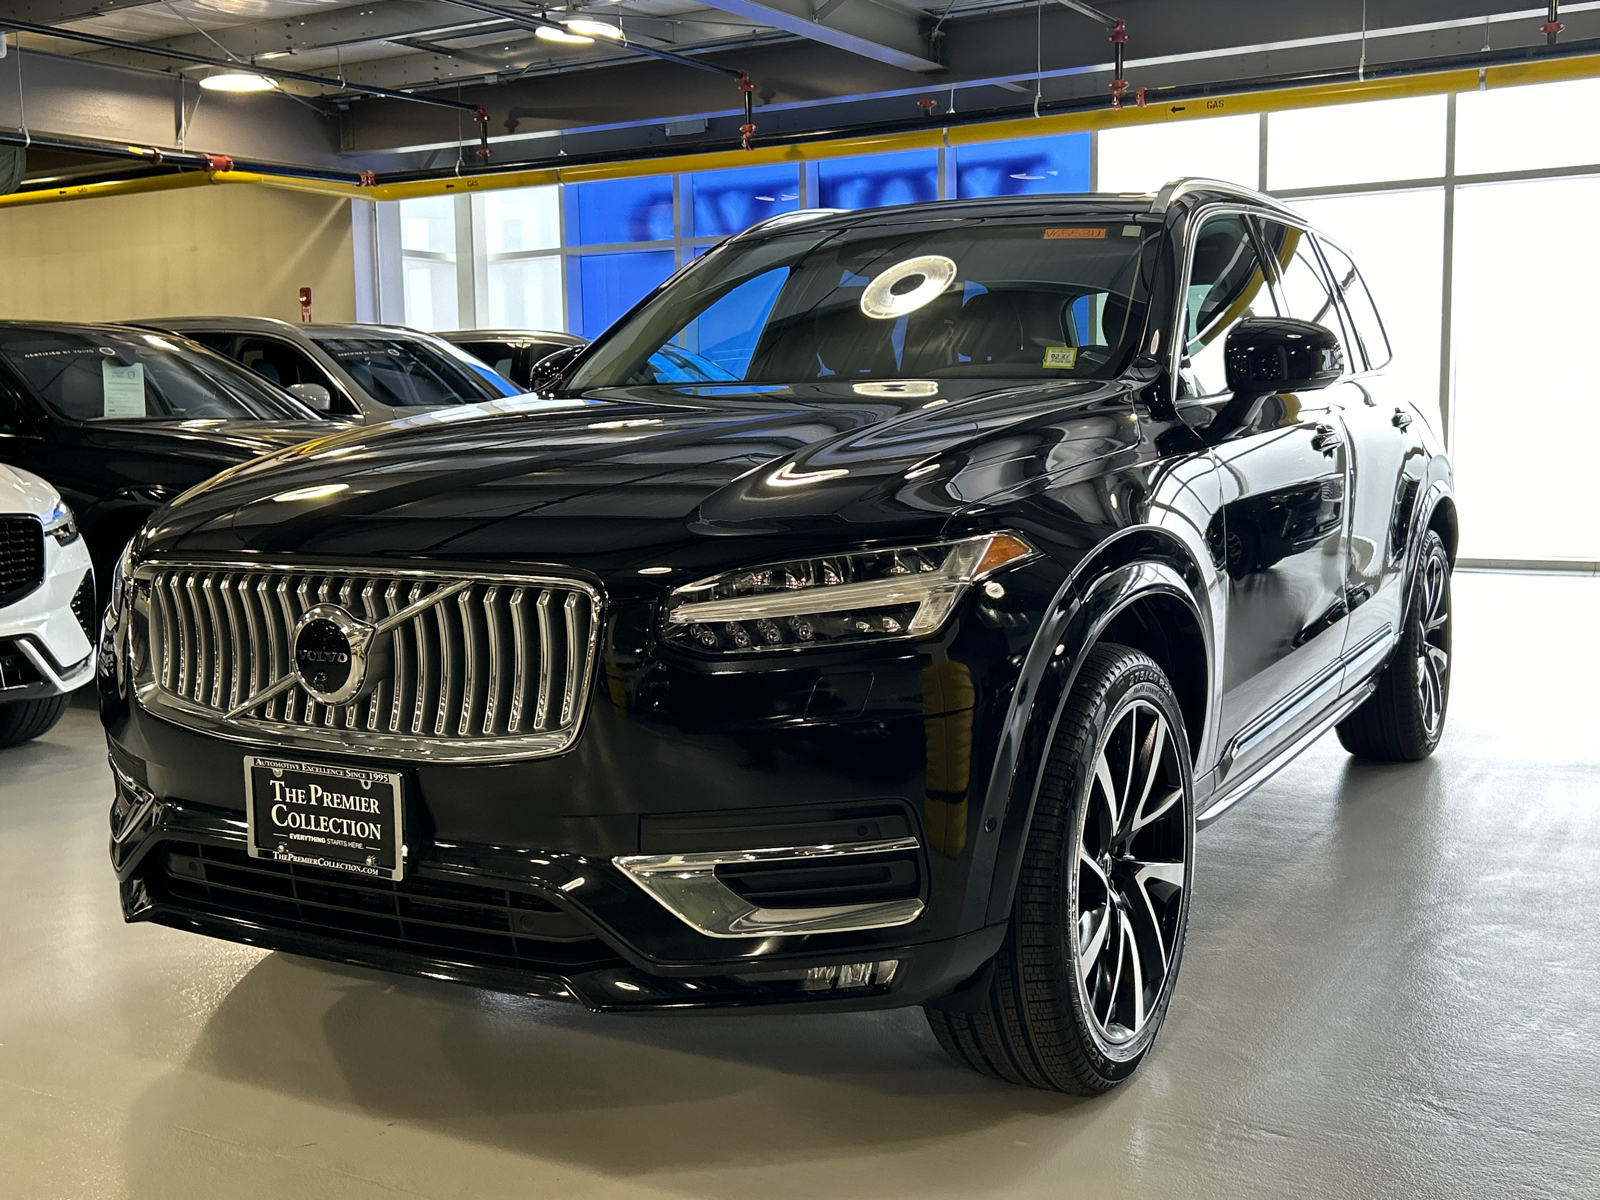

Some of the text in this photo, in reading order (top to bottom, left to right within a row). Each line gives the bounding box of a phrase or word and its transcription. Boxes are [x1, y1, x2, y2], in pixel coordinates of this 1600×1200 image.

[1206, 99, 1225, 110] GAS
[466, 179, 479, 188] GAS
[297, 649, 348, 663] VOLVO
[1128, 670, 1159, 687] 275/40
[255, 758, 389, 782] AUTOMOTIVE EXCELLENCE SINCE 1995
[269, 779, 381, 815] THE PREMIER
[271, 803, 382, 840] COLLECTION
[289, 833, 326, 844] EVERYTHING
[326, 838, 348, 847] STARTS
